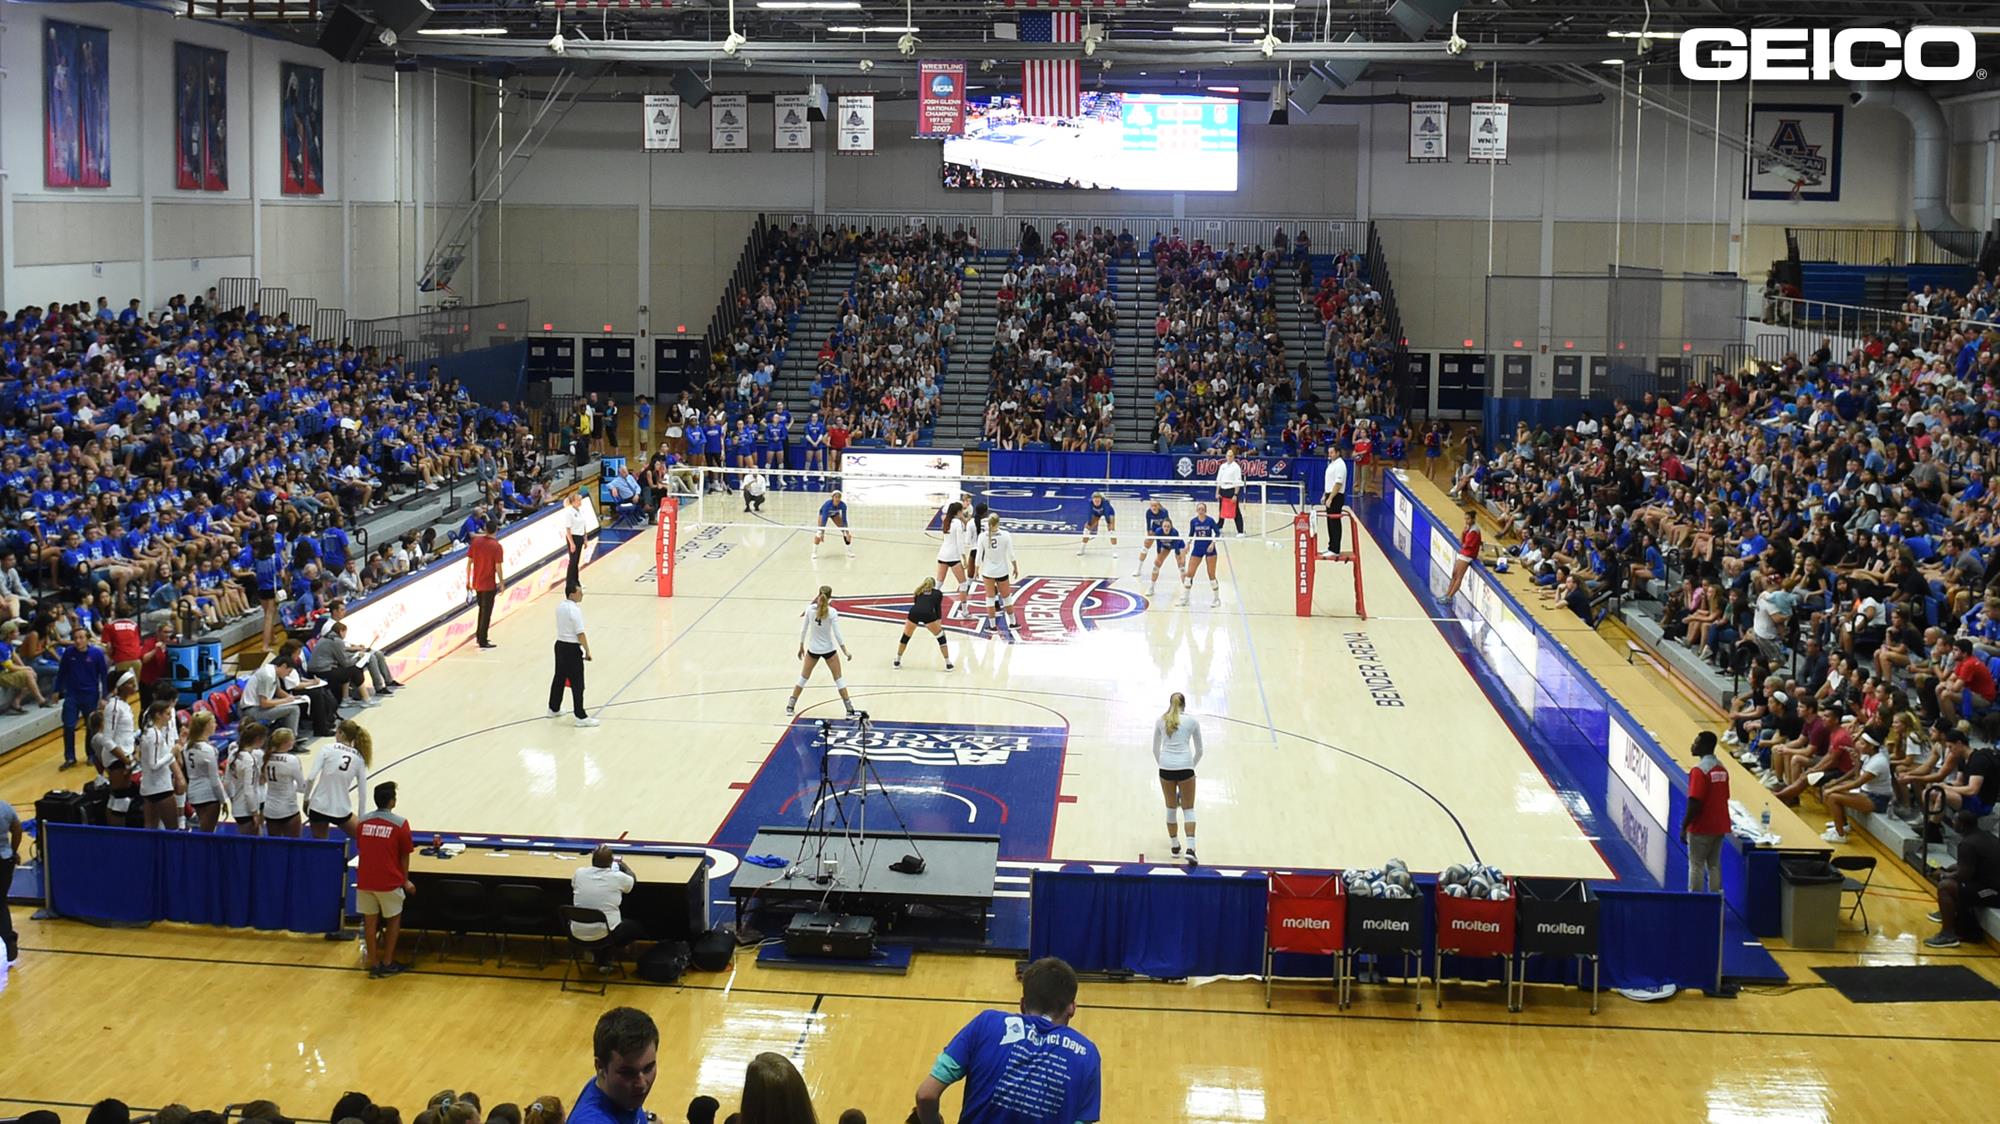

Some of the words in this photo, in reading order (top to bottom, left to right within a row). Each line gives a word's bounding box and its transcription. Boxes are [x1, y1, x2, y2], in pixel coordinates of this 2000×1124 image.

[932, 84, 954, 93] NCAA
[662, 516, 670, 575] AMERICAN
[991, 539, 998, 549] 2
[1299, 533, 1308, 594] AMERICAN
[1342, 631, 1382, 662] ARENA
[1358, 664, 1405, 706] BENDER
[188, 753, 195, 769] 5
[338, 755, 352, 772] 3
[267, 765, 278, 782] 11
[1282, 917, 1330, 930] molten
[1362, 919, 1410, 932] molten
[1451, 919, 1500, 933] molten
[1537, 921, 1585, 935] molten
[1062, 1036, 1087, 1055] Days
